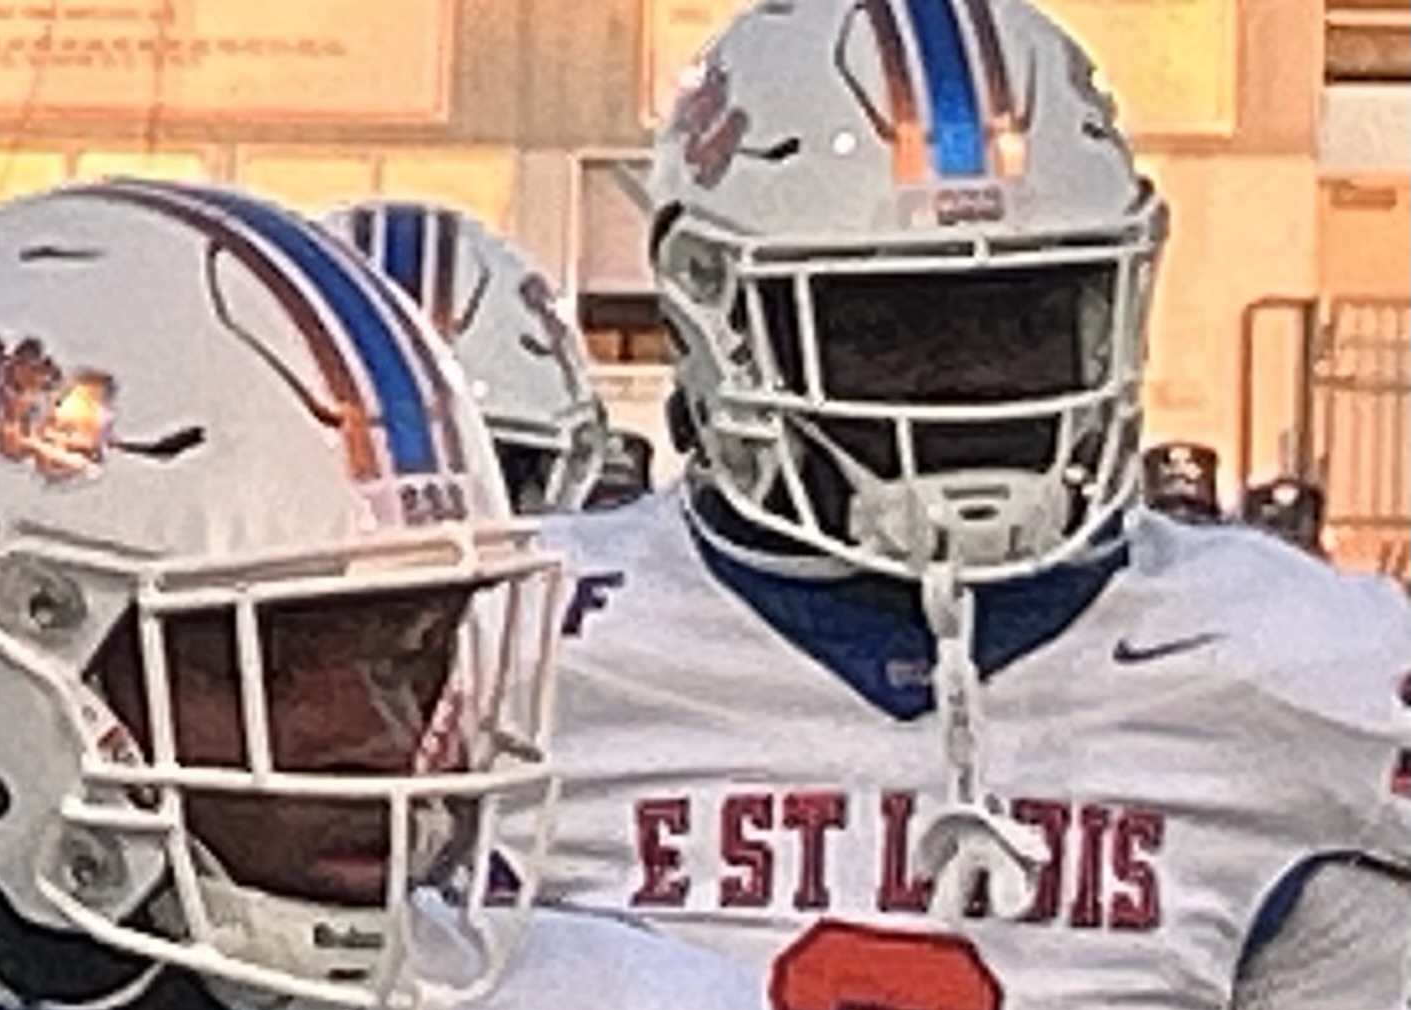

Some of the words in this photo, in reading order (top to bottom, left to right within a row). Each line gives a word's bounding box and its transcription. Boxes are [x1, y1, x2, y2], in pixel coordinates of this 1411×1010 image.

[561, 571, 624, 638] F
[630, 797, 690, 908] E
[720, 793, 847, 912] ST
